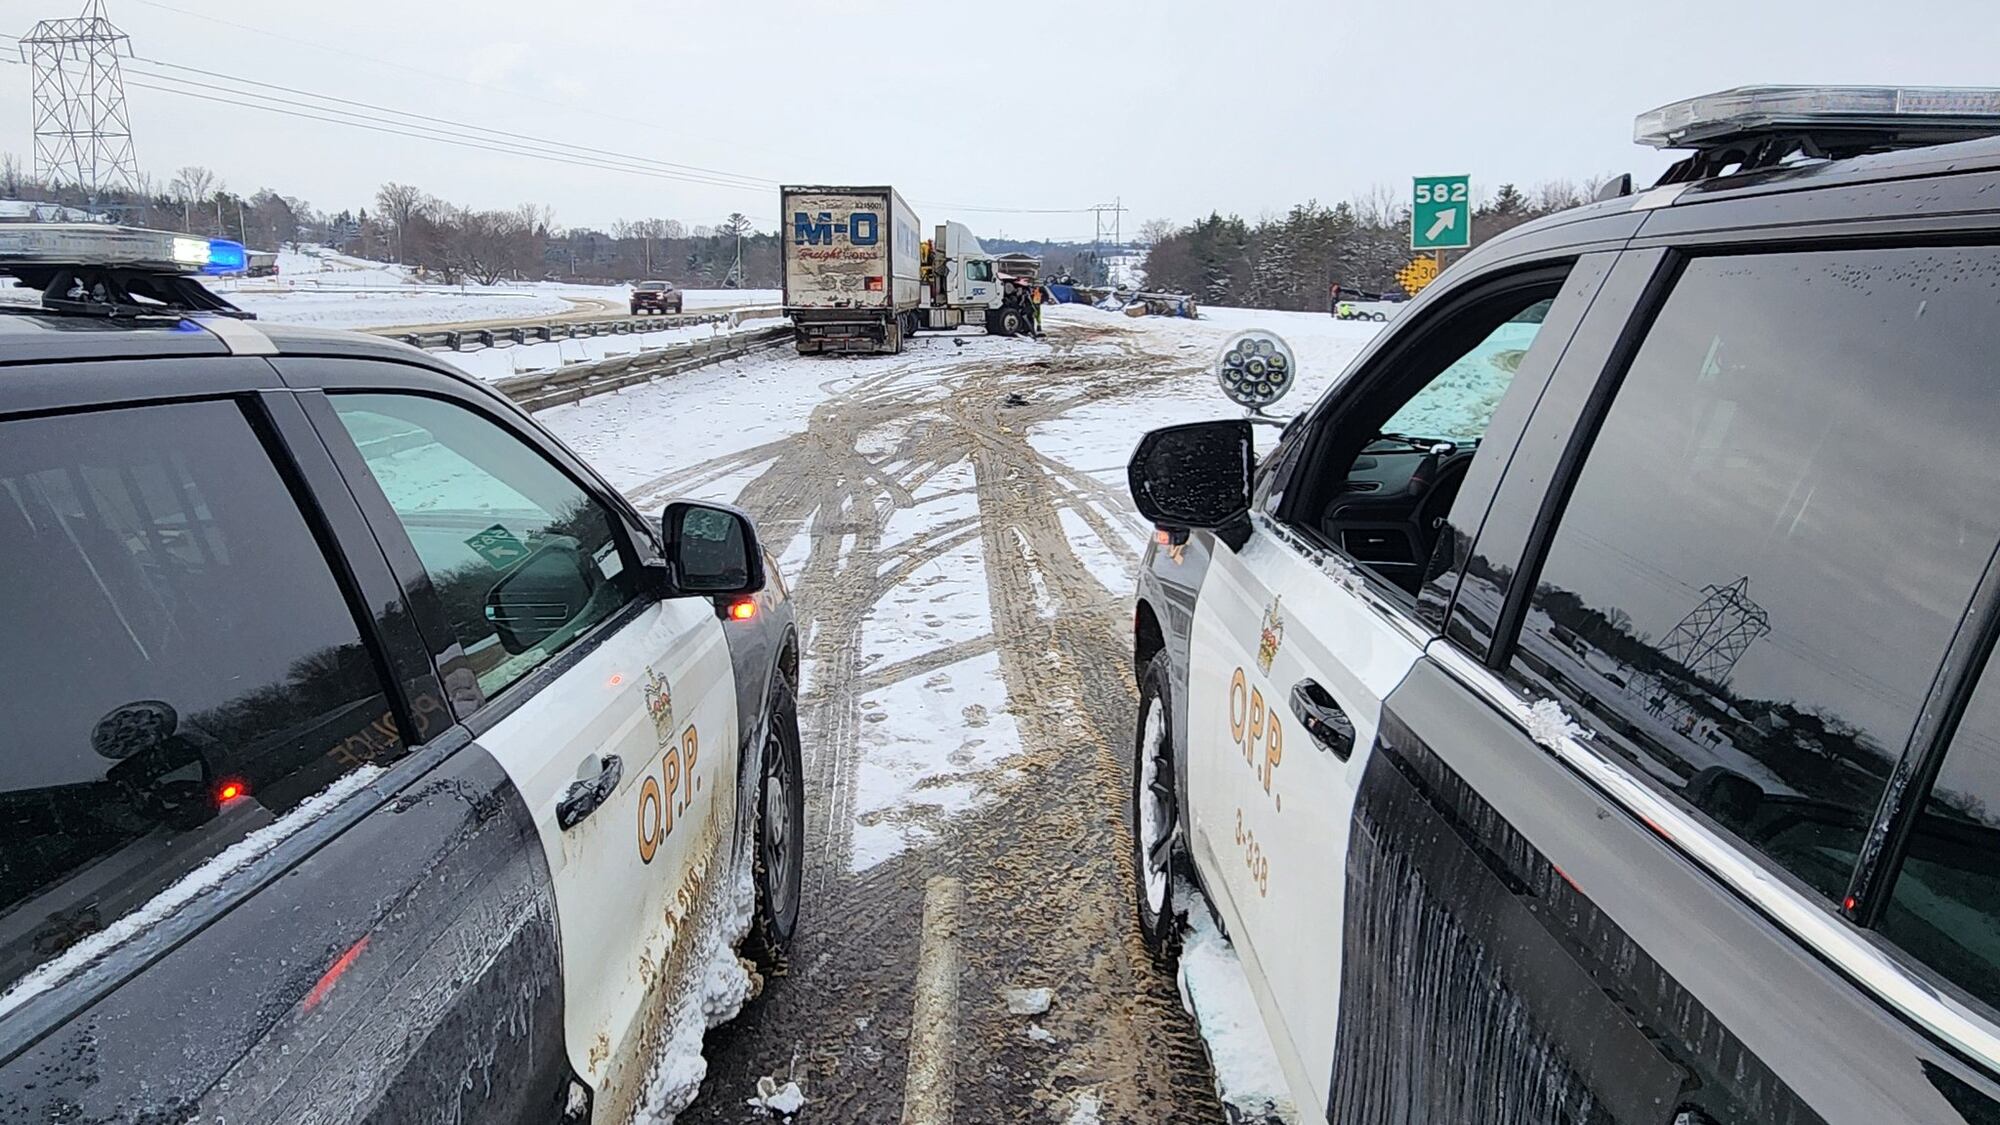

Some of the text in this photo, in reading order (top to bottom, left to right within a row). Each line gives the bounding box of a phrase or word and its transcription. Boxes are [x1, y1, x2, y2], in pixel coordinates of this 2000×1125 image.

[794, 211, 879, 246] M-O
[1416, 183, 1467, 203] 582
[1229, 666, 1283, 813] O.P.P.
[637, 723, 702, 865] O.P.P.
[1235, 807, 1268, 898] 3-338
